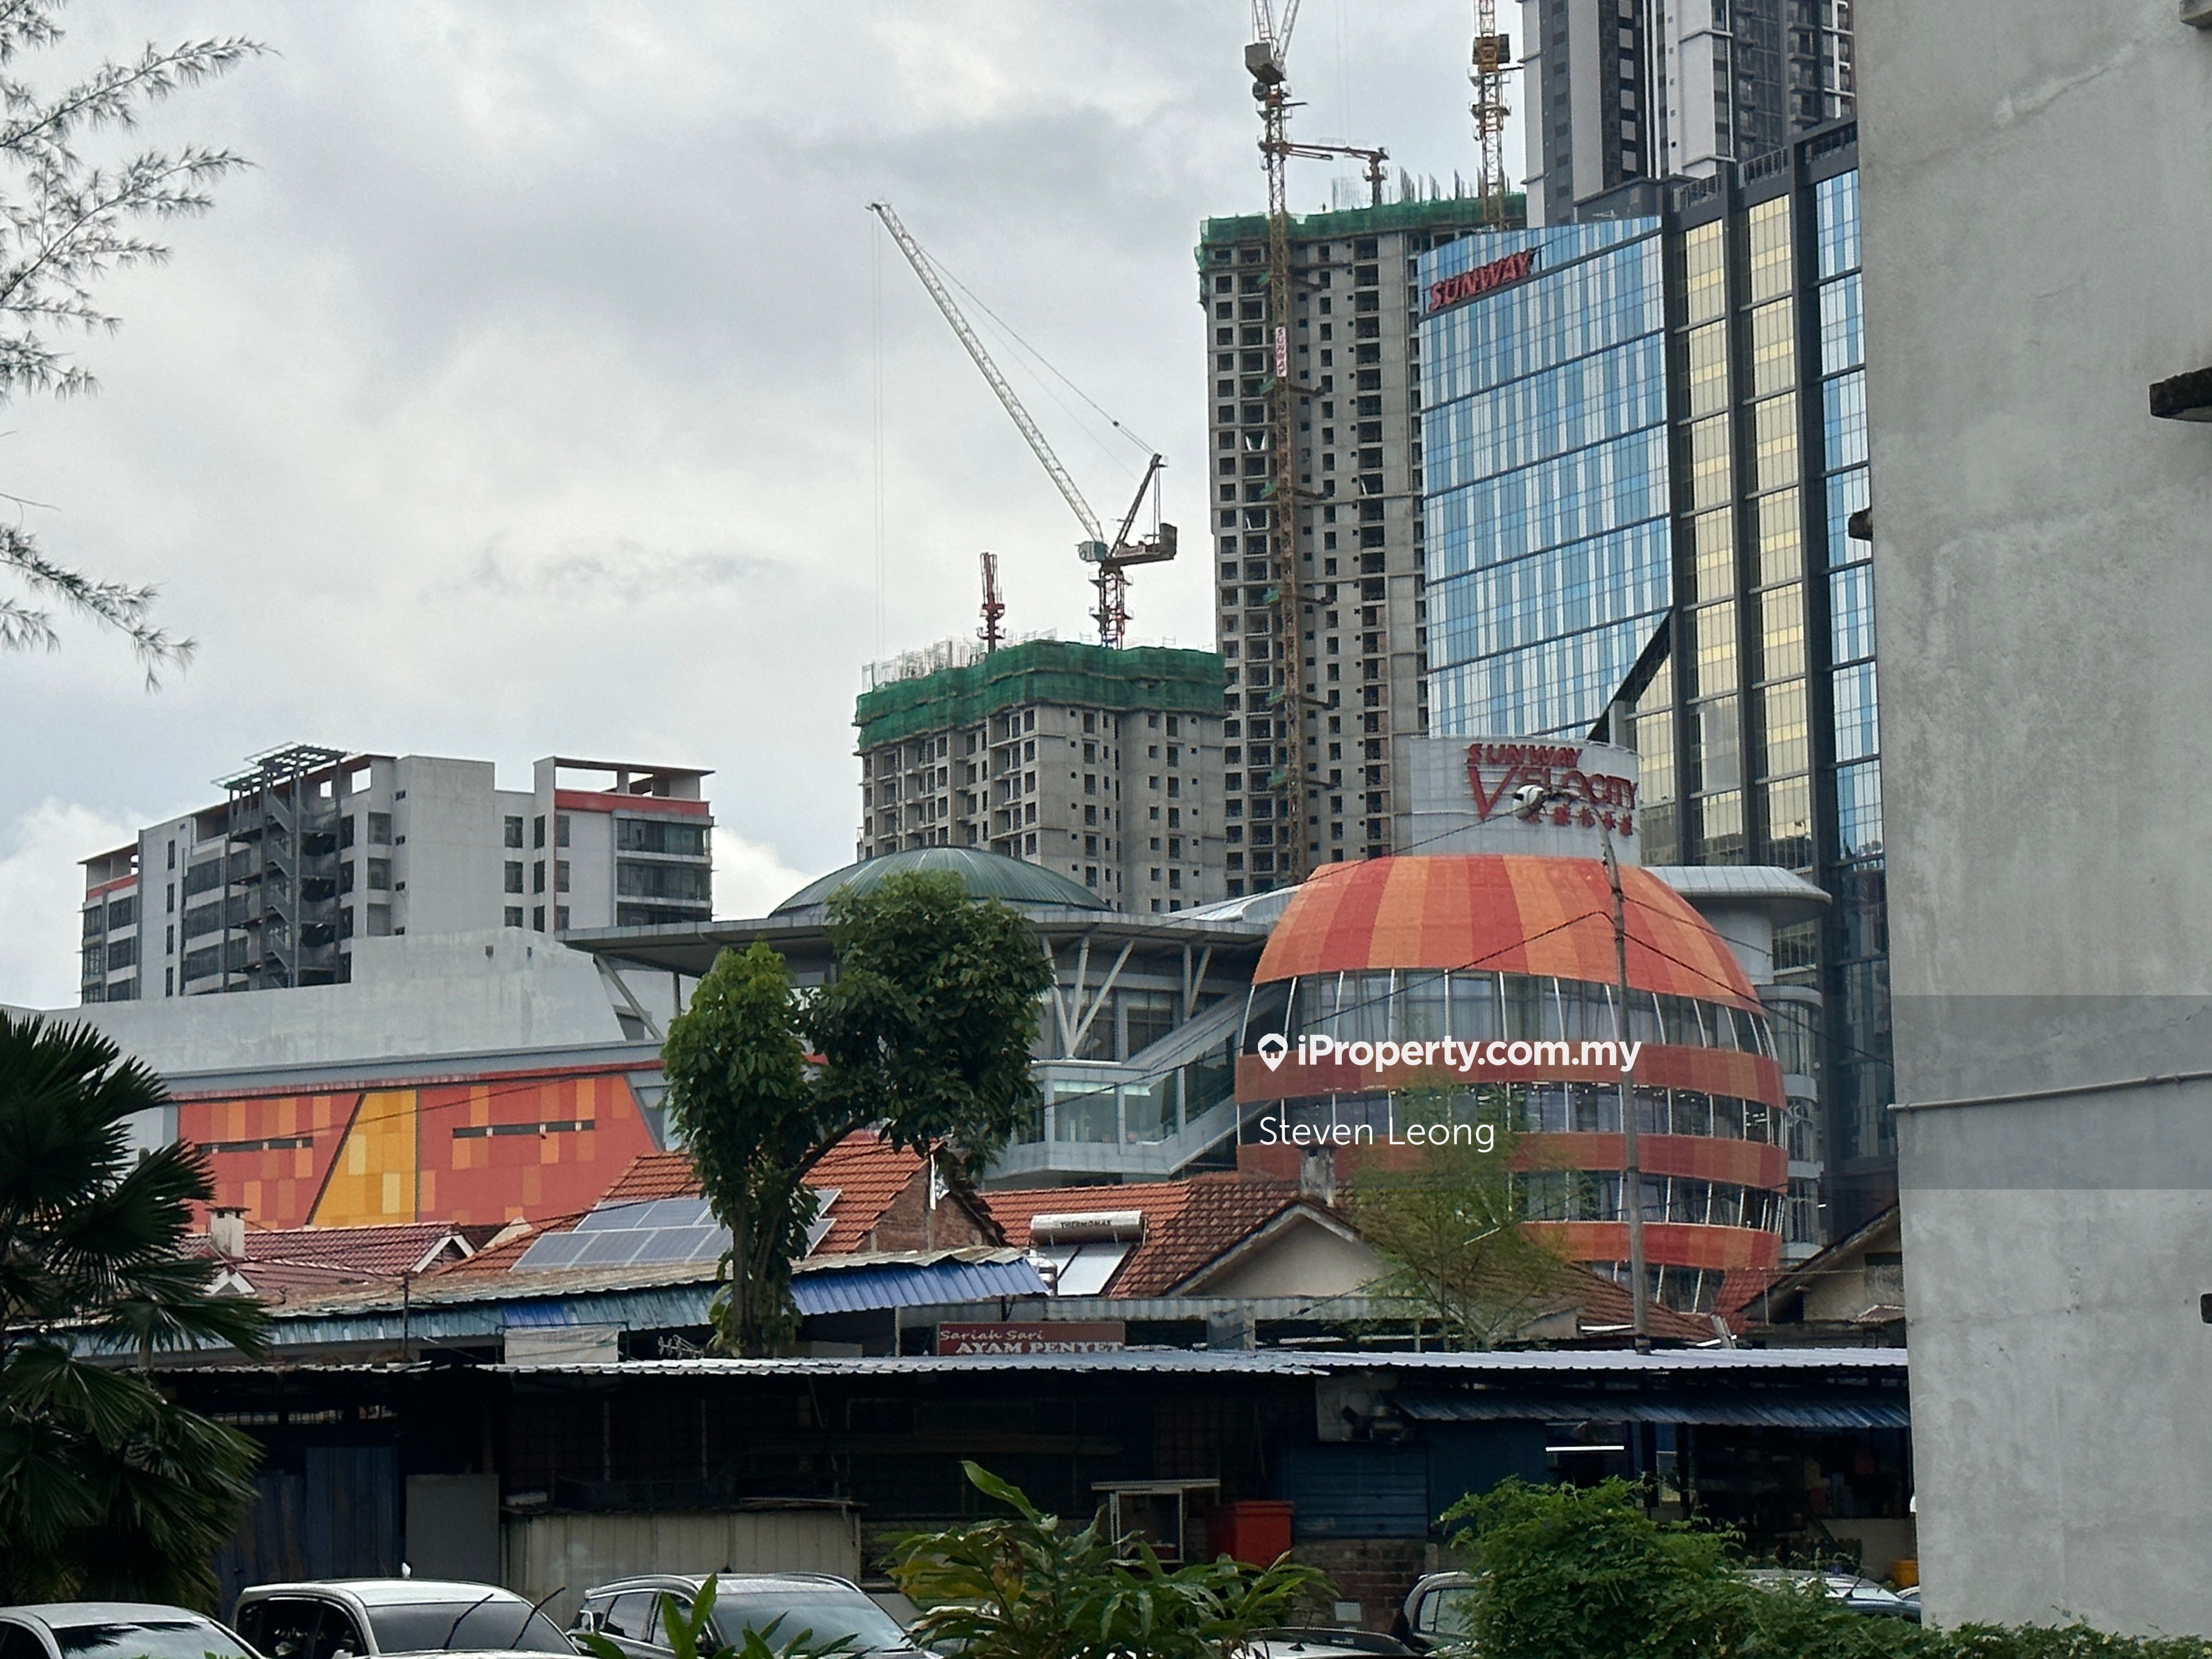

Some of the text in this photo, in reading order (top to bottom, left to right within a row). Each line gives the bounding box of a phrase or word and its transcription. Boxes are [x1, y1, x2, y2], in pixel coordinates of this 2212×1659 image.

[1429, 248, 1534, 311] SUNWAY
[1466, 743, 1583, 768] SUNWAY
[1006, 1330, 1044, 1340] Sari
[956, 1341, 1124, 1355] AYAM PENYET
